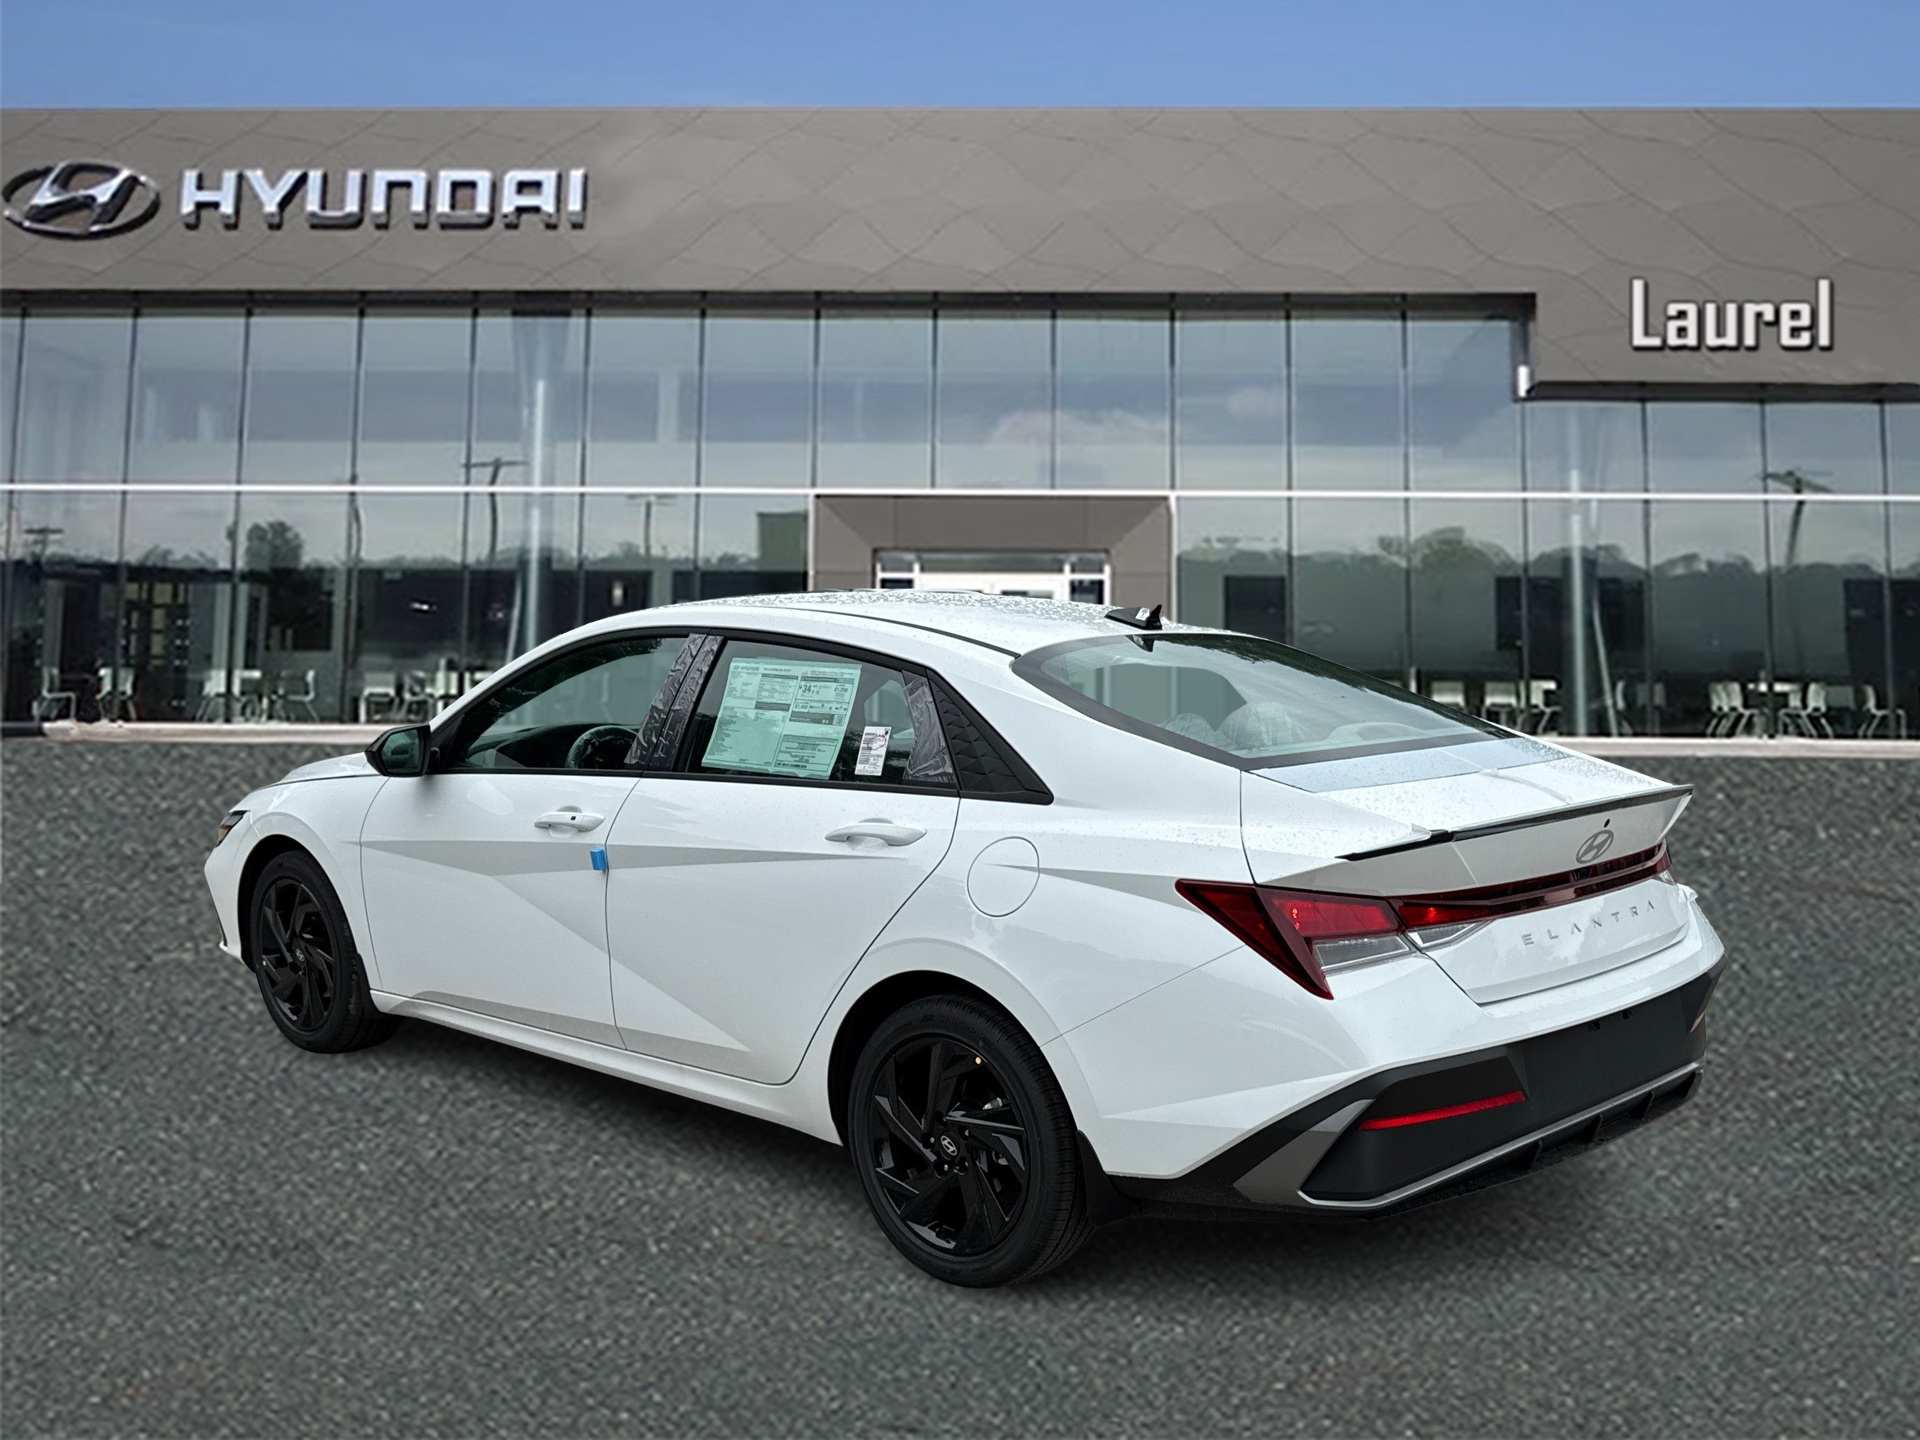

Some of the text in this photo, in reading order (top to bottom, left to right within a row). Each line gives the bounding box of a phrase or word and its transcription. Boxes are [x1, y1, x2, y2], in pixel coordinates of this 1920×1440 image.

[180, 169, 588, 230] HYUNDAI
[1630, 277, 1832, 349] Laurel
[1521, 900, 1655, 946] ELANTRA
